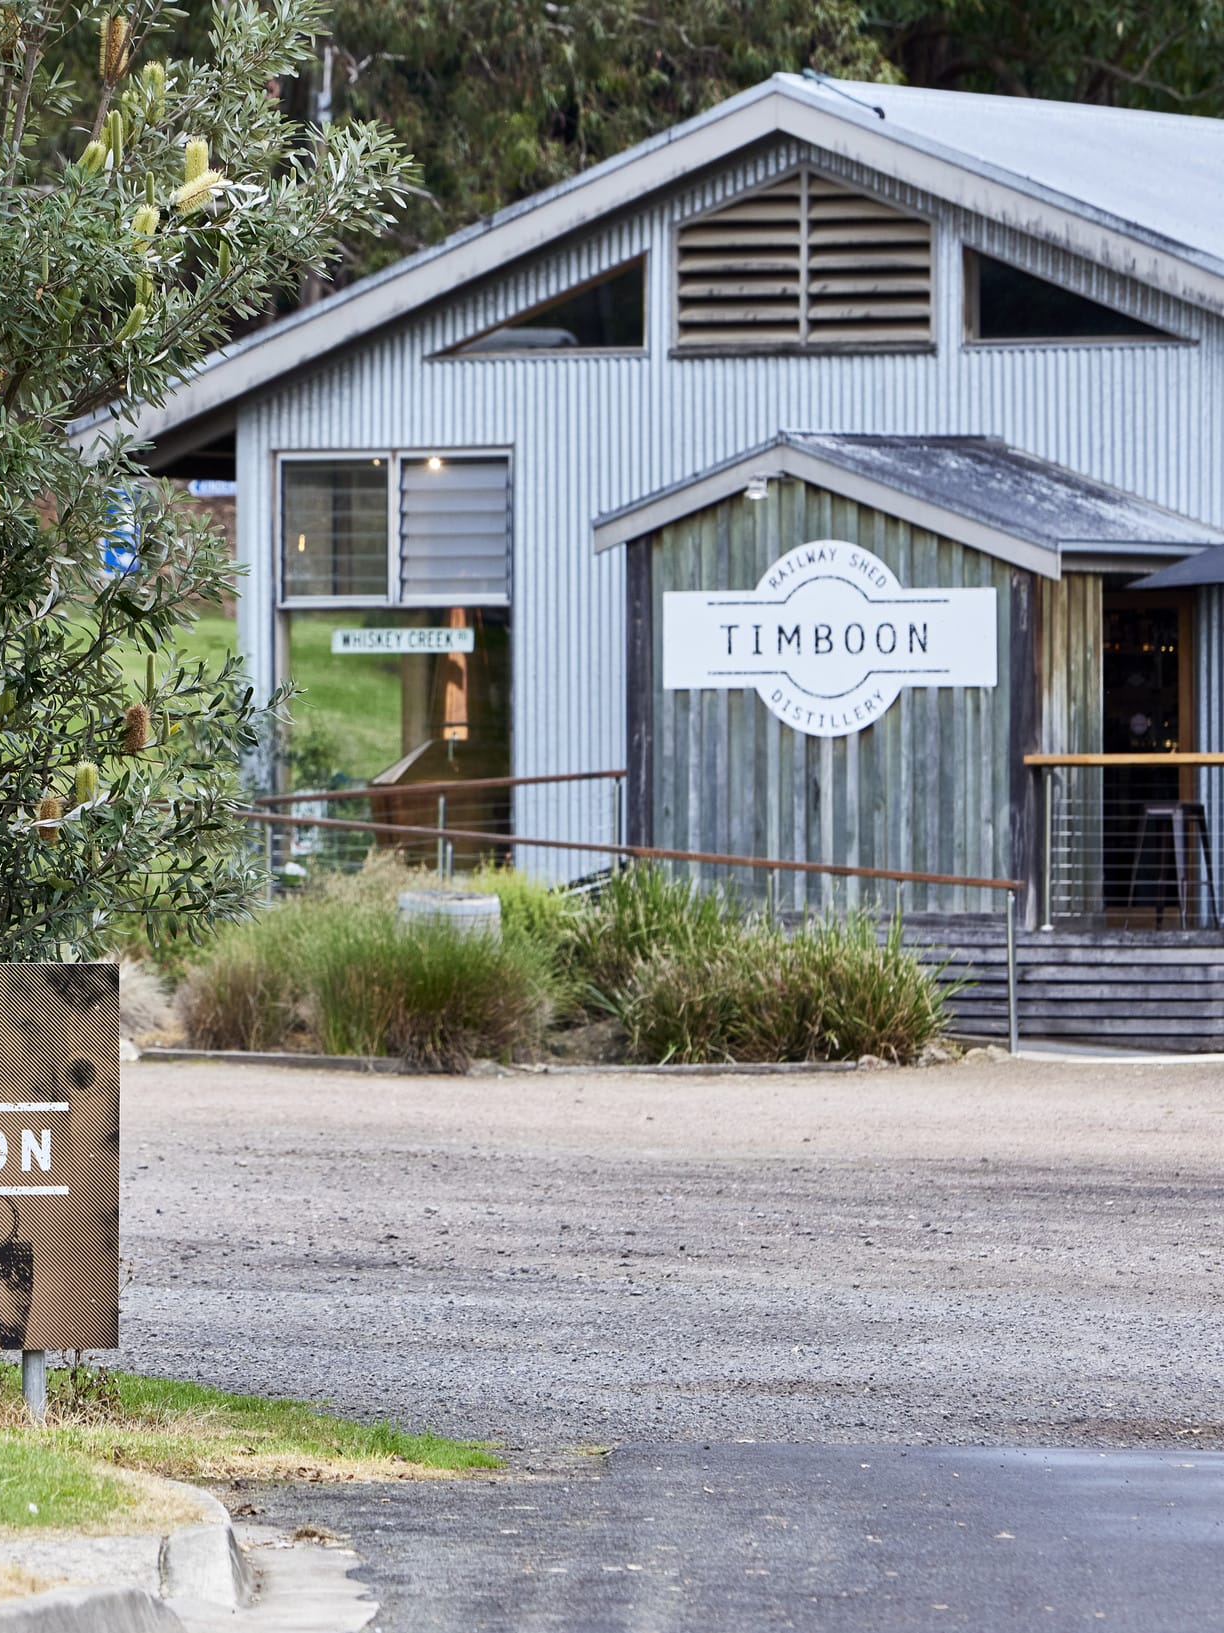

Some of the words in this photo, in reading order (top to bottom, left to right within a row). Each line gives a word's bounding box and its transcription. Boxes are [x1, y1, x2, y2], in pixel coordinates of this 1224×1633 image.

[769, 548, 837, 589] RAILWAY
[849, 554, 887, 588] SHED
[342, 630, 401, 648] WHISKEY
[408, 630, 454, 648] CREEK
[720, 623, 928, 655] TIMBOON
[771, 689, 884, 729] DISTILLERY
